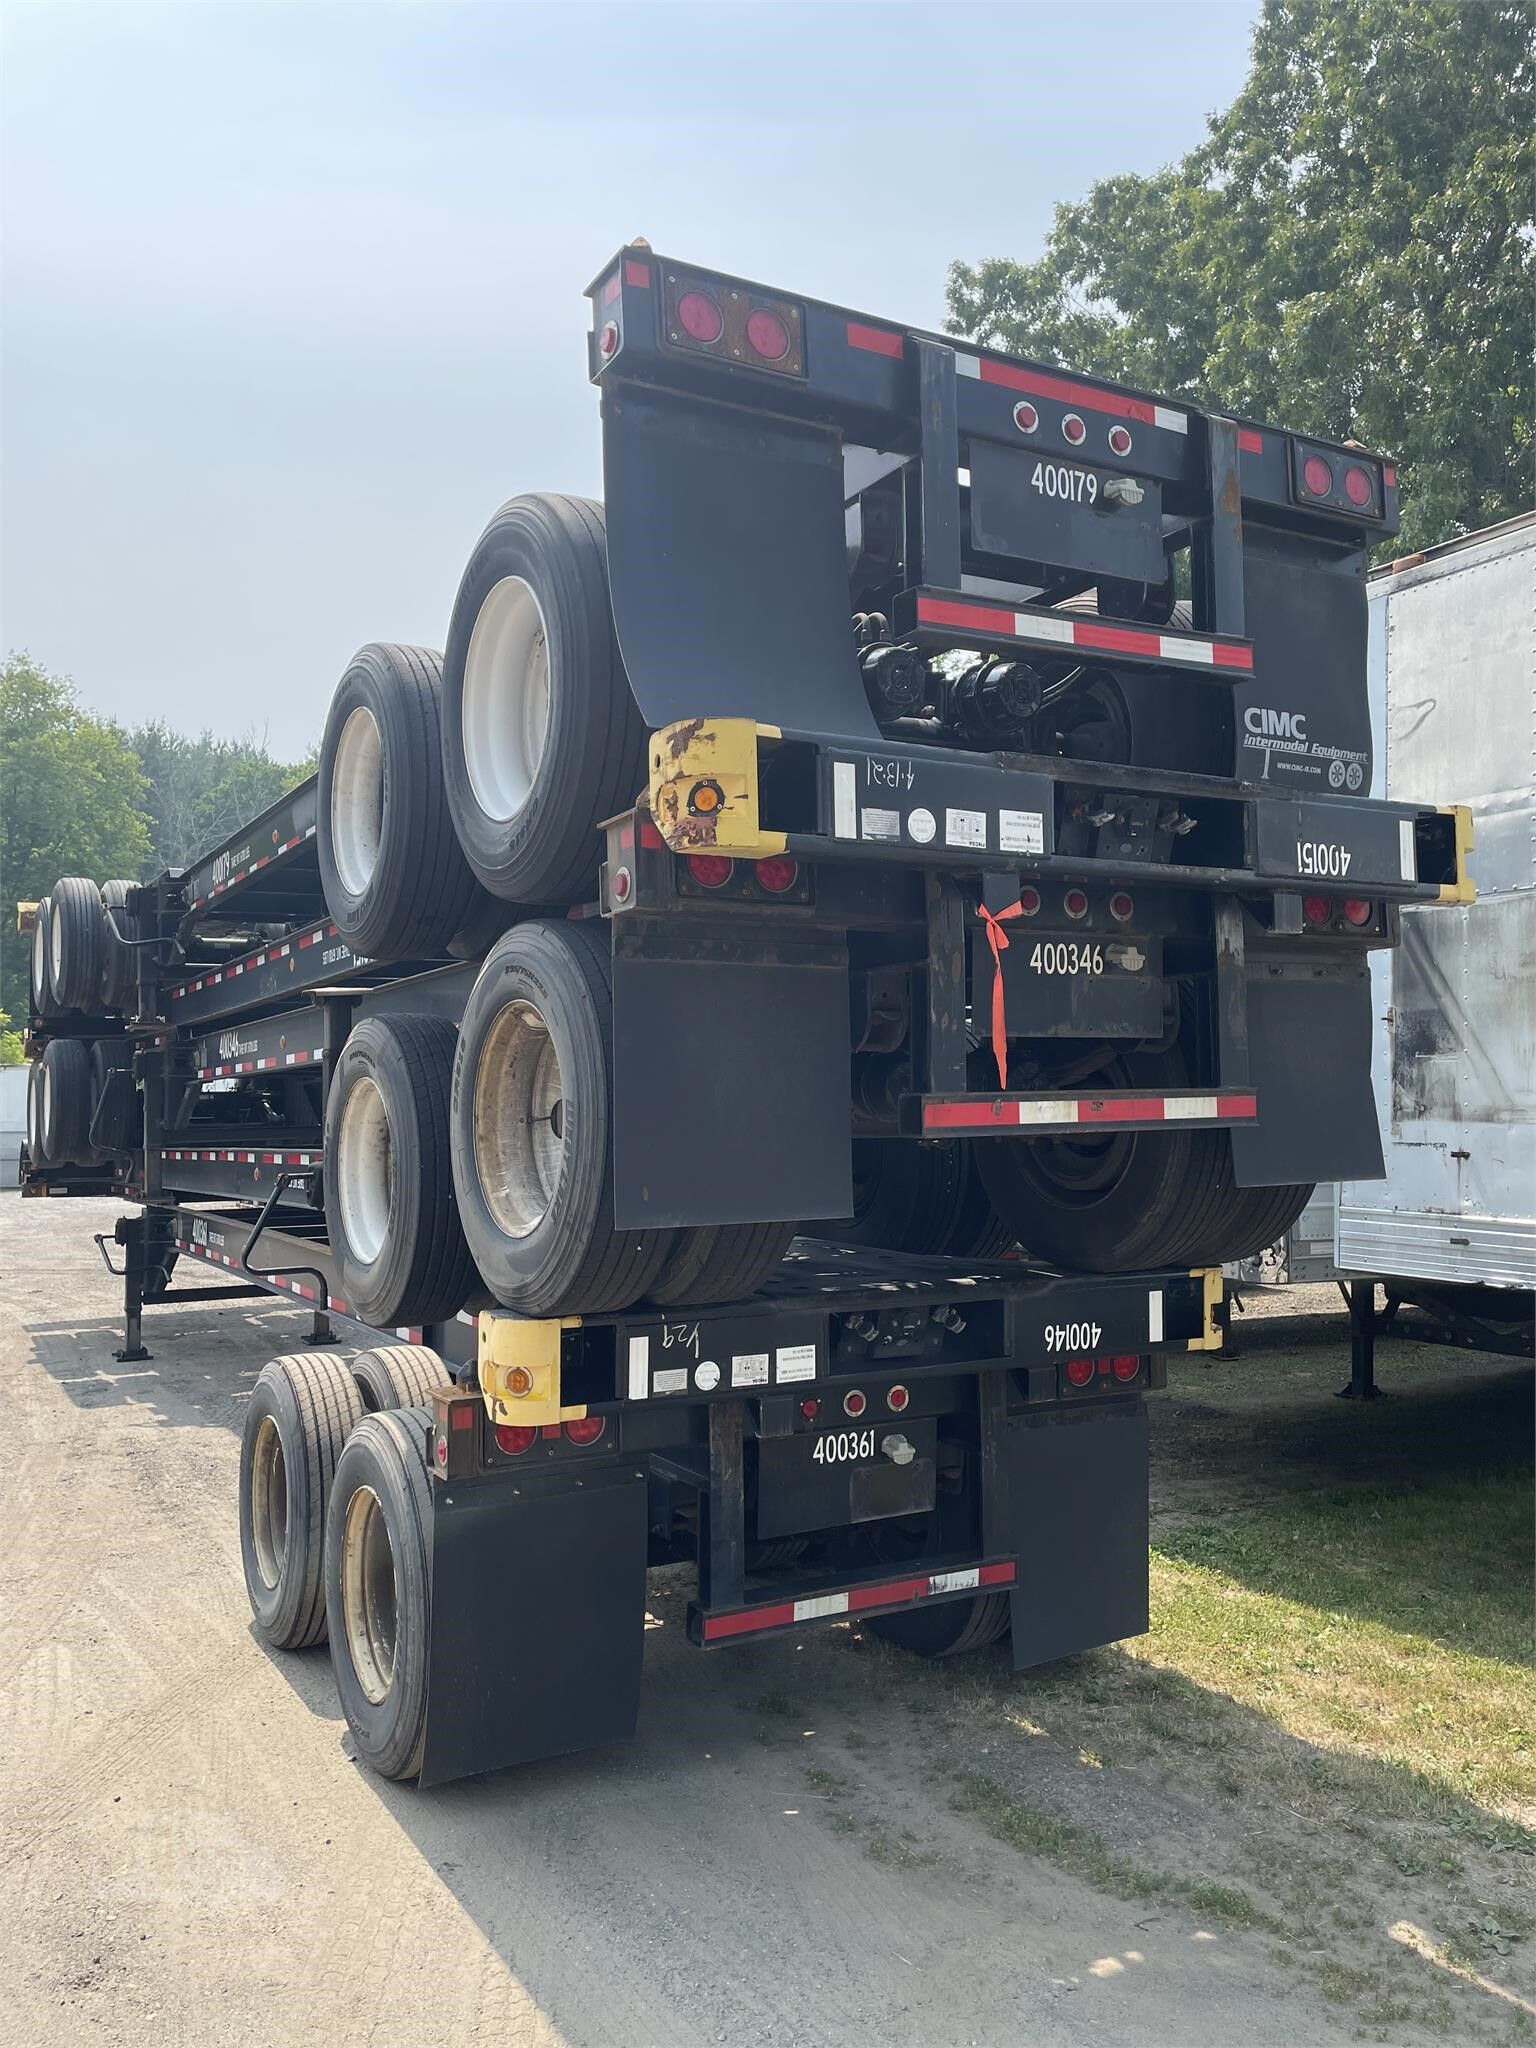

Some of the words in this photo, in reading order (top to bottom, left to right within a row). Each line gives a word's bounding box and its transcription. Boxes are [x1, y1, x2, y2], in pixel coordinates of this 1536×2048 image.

[1031, 462, 1098, 504] 400179
[1244, 707, 1307, 740] CIMC
[1243, 733, 1309, 753] Intermodal
[1311, 743, 1369, 761] Equipment
[212, 850, 230, 886] 400179
[1297, 842, 1351, 876] 400151
[1029, 943, 1104, 975] 400346
[219, 1031, 239, 1060] 400346
[1045, 1322, 1102, 1352] 400146
[813, 1429, 875, 1464] 400361
